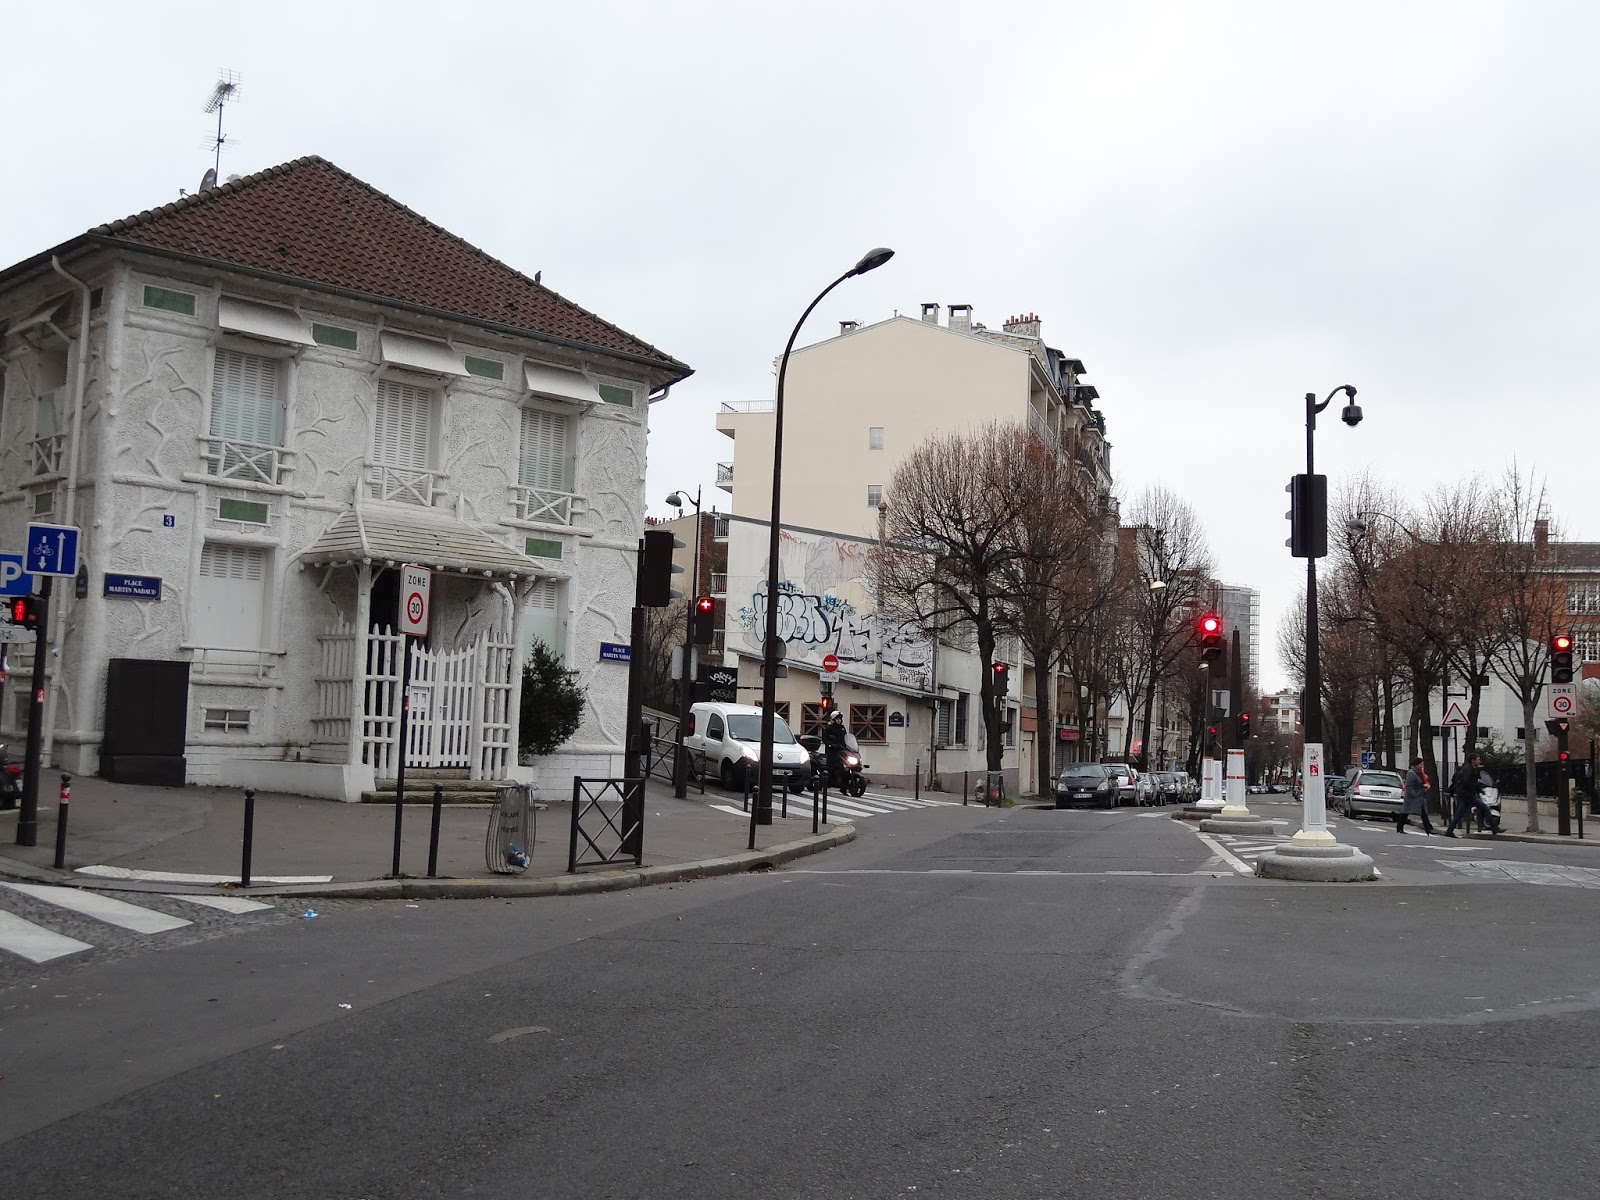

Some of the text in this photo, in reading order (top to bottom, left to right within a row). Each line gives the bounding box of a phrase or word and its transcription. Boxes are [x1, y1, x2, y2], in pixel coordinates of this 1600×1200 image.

[165, 516, 172, 526] 3
[1, 561, 22, 588] P
[408, 575, 426, 587] ZONE
[109, 585, 157, 595] MARTIN NADAUD
[411, 602, 420, 614] 30
